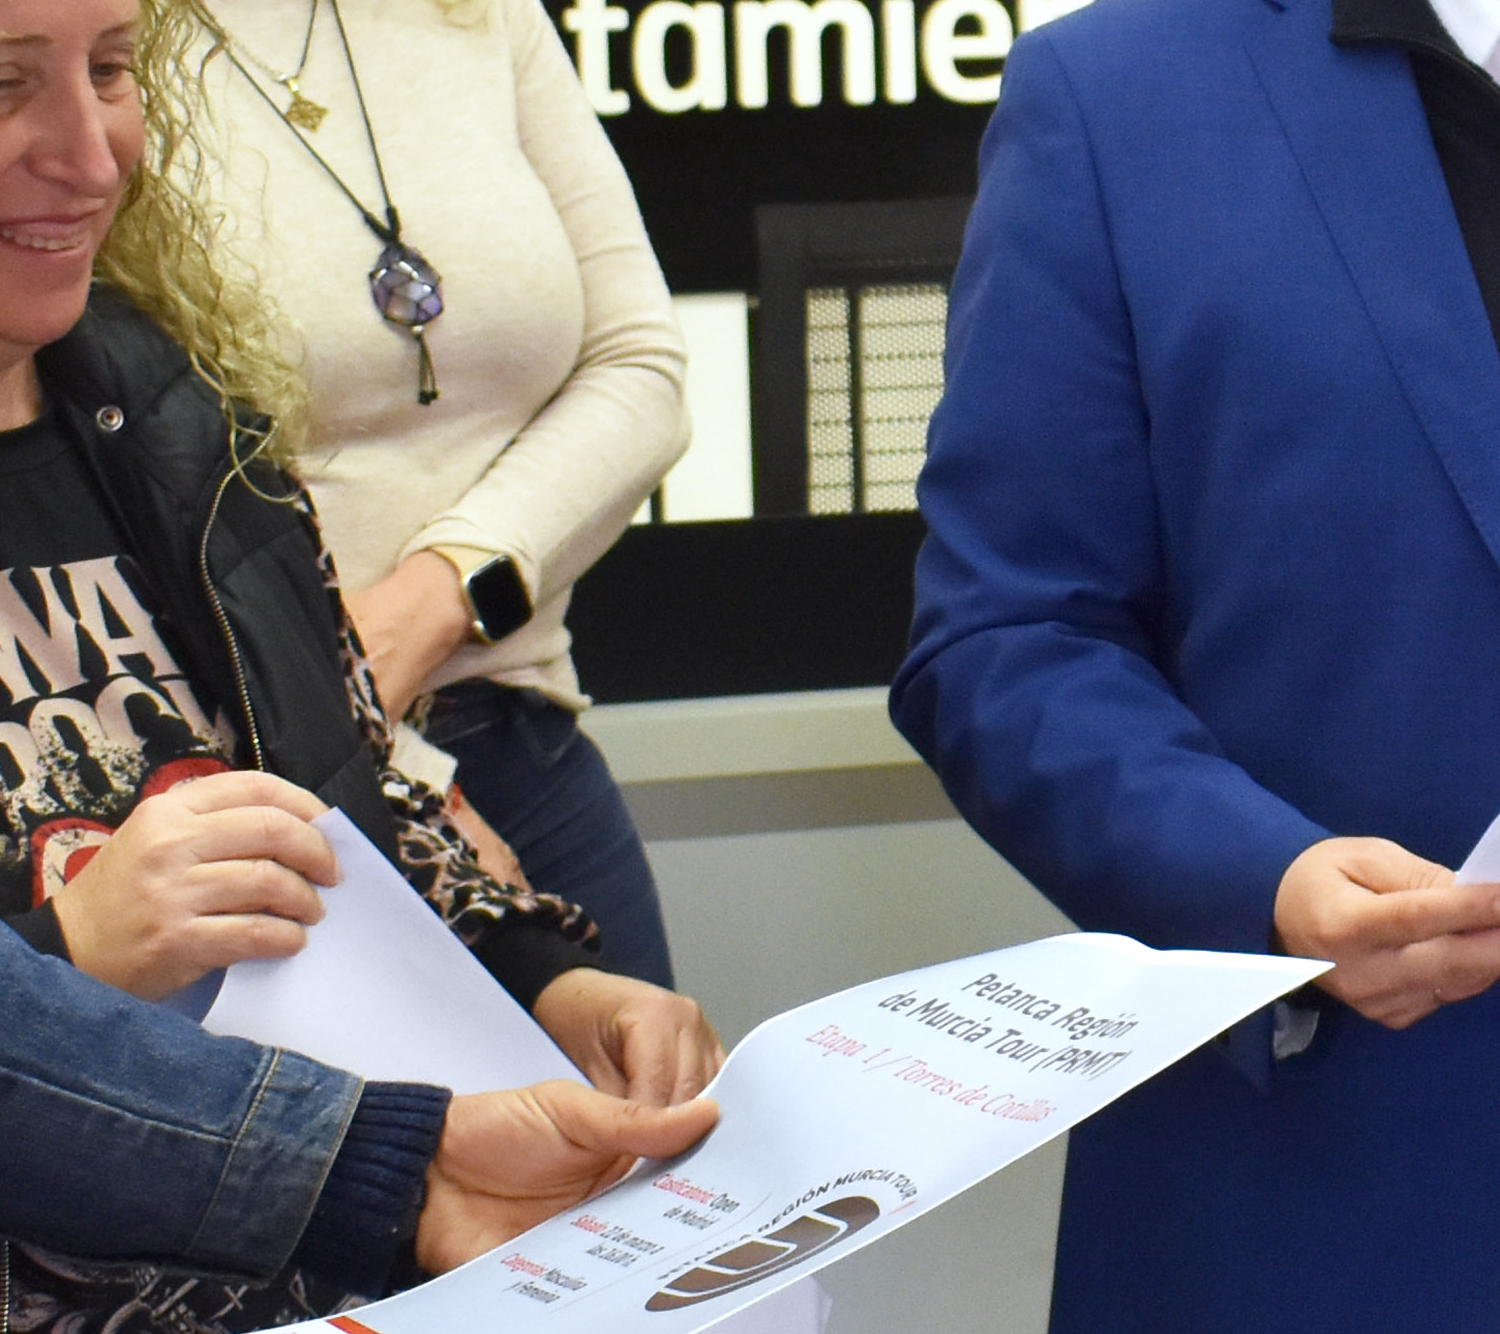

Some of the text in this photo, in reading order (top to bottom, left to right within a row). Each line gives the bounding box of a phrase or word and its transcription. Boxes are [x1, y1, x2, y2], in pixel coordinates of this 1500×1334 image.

[878, 990, 1134, 1082] de Murcia Tour (PRMT)
[961, 973, 1139, 1041] Petanca Región
[806, 1024, 867, 1058] Etapa
[894, 1059, 962, 1096] Torres
[953, 1084, 990, 1106] de
[833, 1168, 895, 1190] MURCIA
[892, 1173, 918, 1201] TOUR
